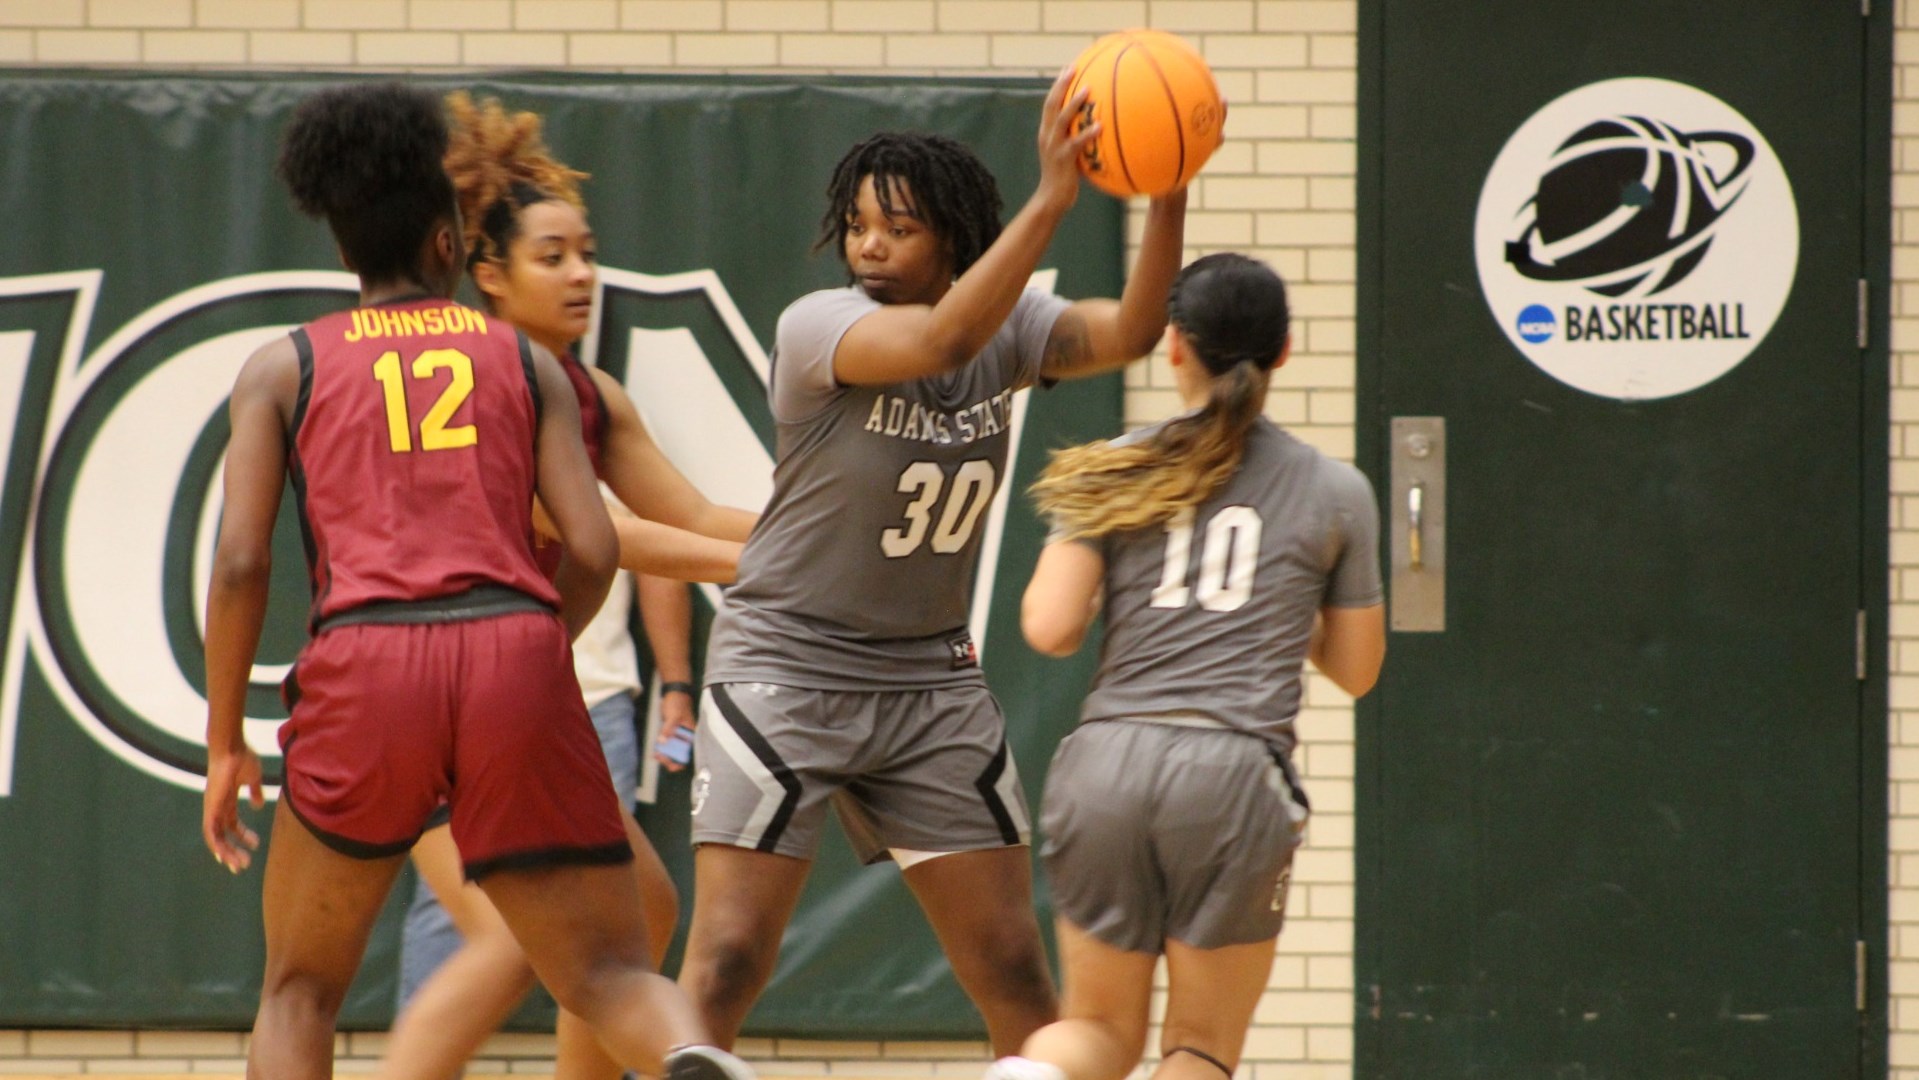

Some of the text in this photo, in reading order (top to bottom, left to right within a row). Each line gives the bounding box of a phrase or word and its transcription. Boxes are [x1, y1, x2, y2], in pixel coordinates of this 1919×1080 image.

[344, 305, 488, 342] JOHNSON
[1565, 302, 1750, 341] BASKETBALL
[372, 348, 478, 453] 12
[864, 393, 952, 444] ADAMS
[880, 459, 995, 558] 30
[1149, 505, 1263, 612] 10
